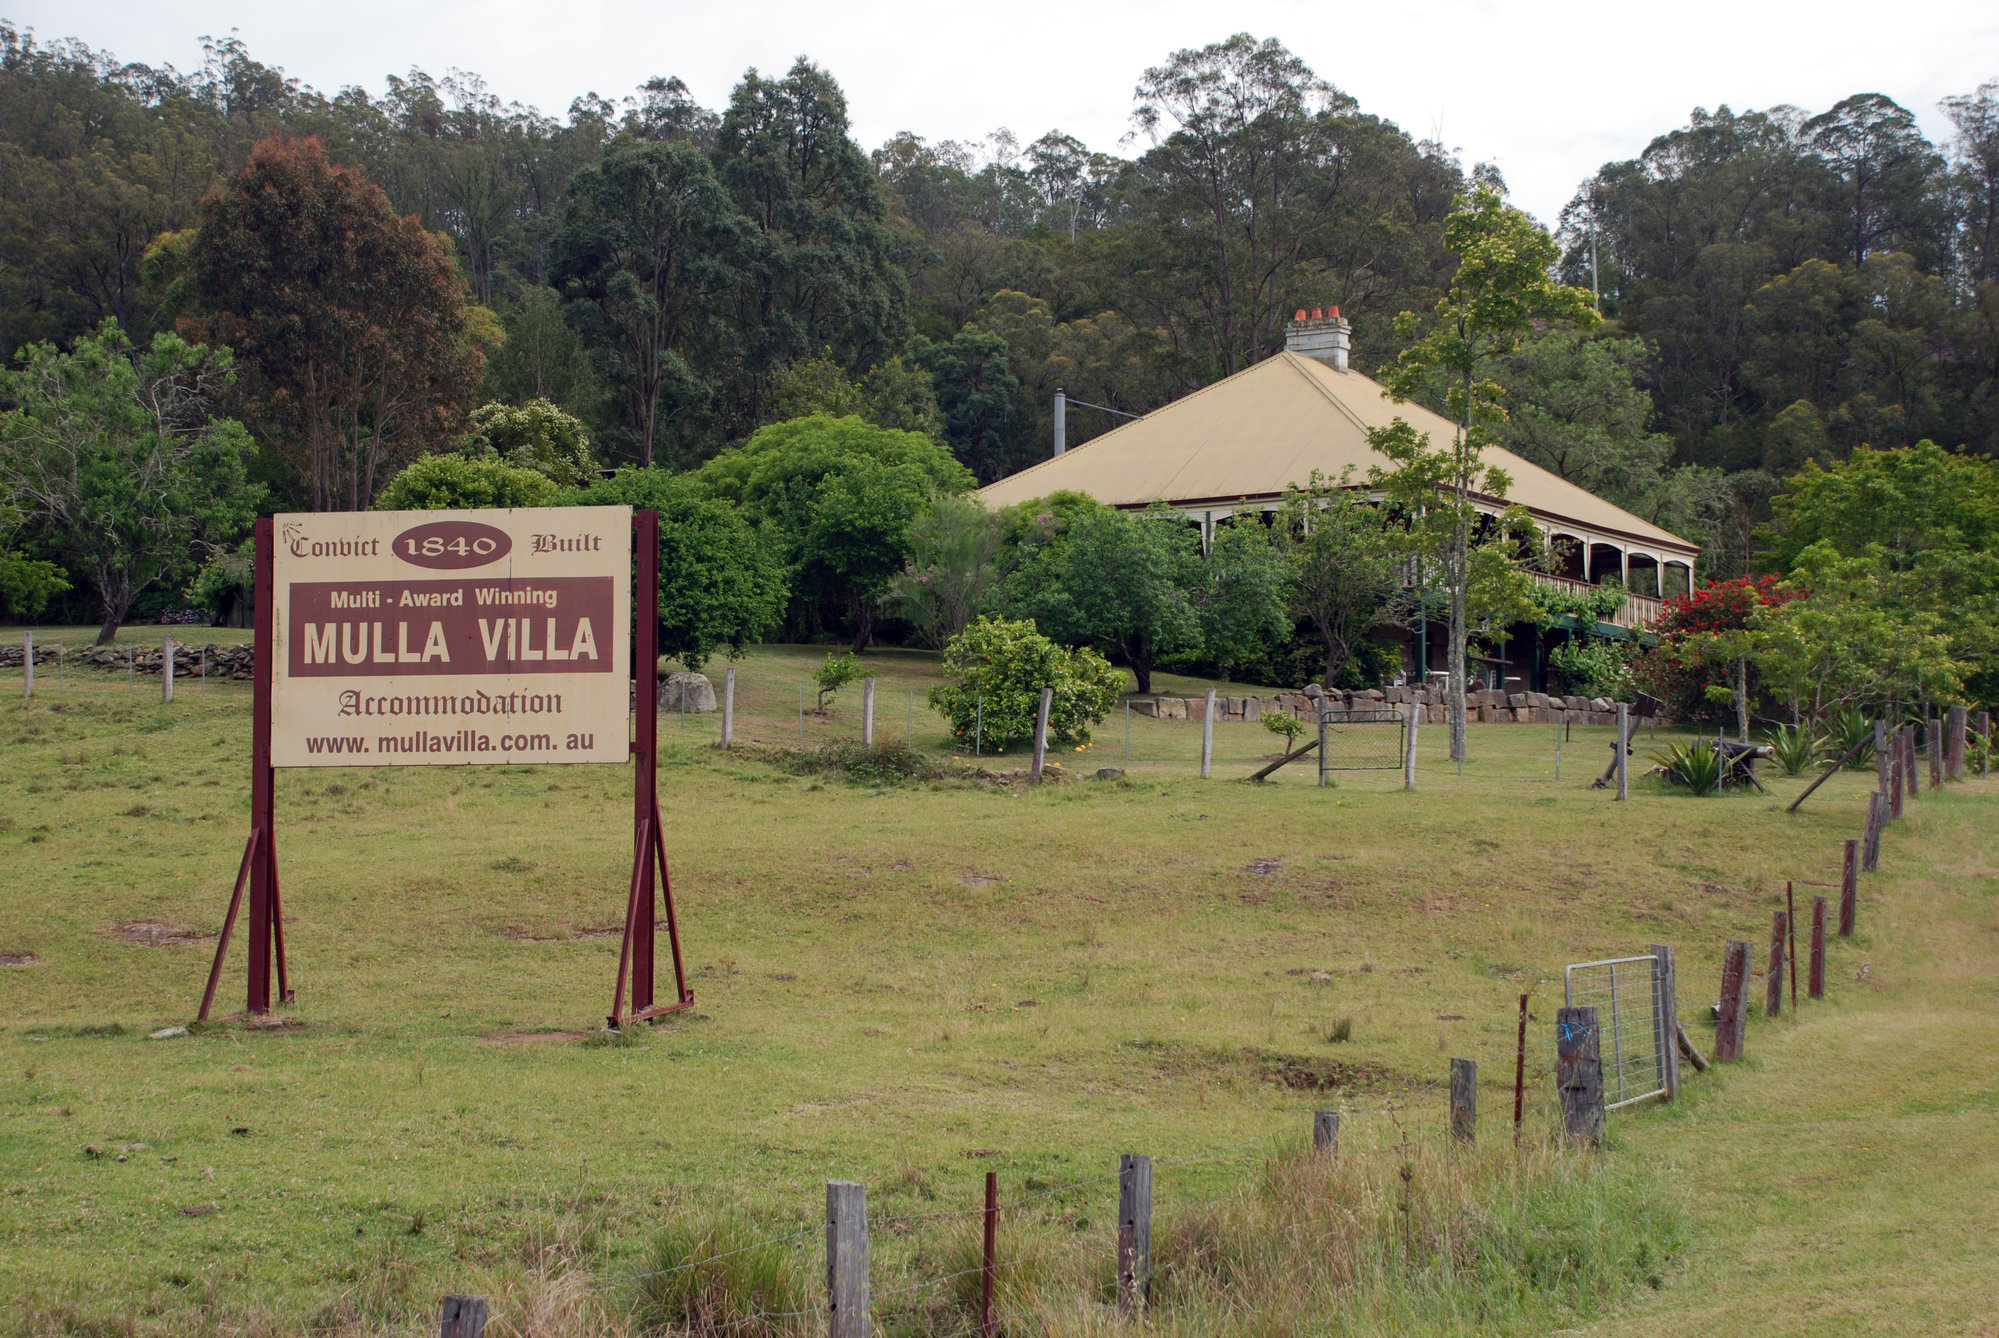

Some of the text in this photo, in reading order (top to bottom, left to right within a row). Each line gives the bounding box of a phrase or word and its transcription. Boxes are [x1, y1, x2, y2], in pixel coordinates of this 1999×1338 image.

[290, 534, 602, 558] Convict 1840 Built
[475, 587, 557, 609] Winning
[304, 617, 599, 665] MULLA VILLA
[338, 687, 563, 718] Accommodation
